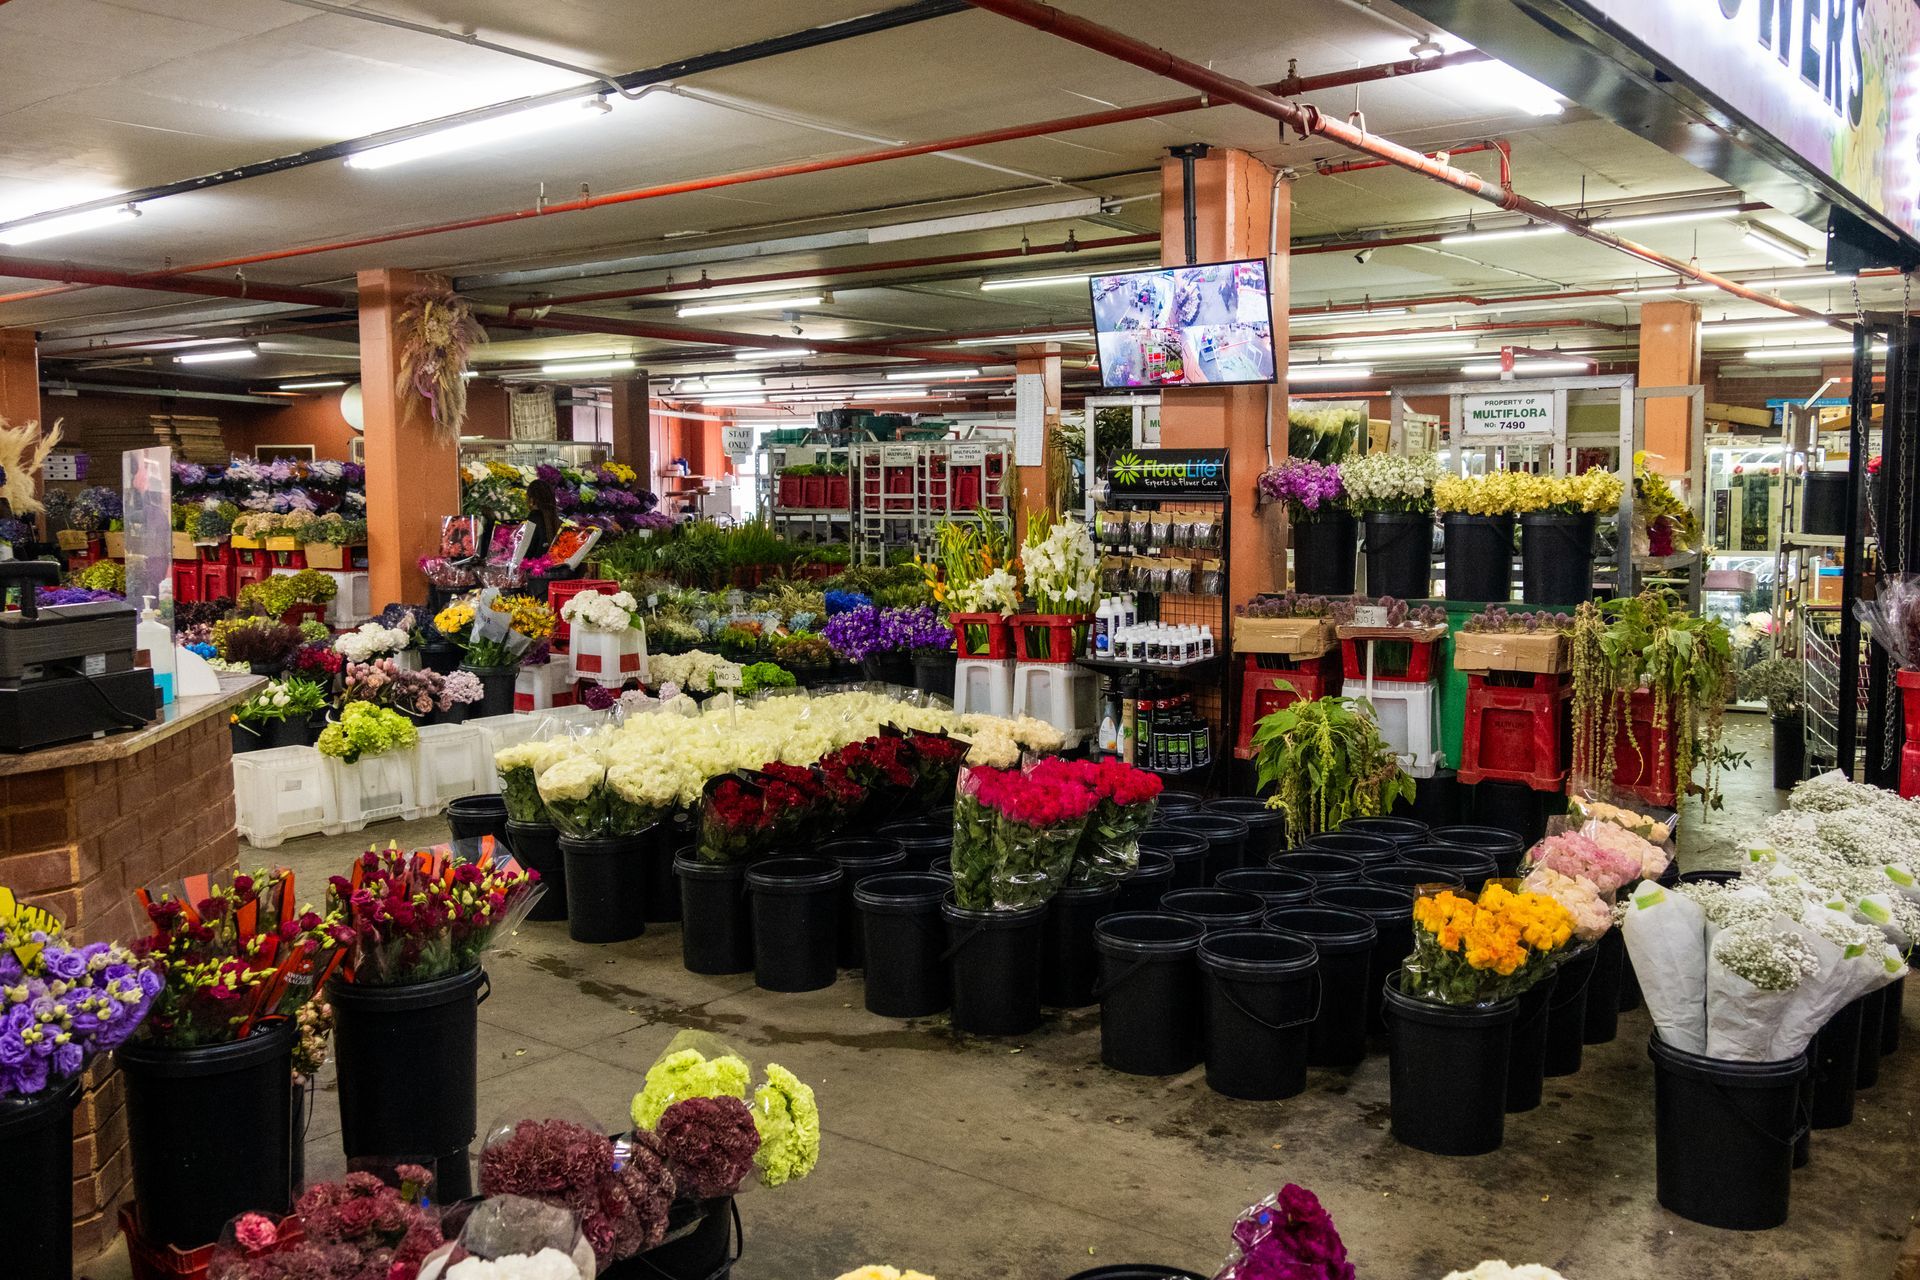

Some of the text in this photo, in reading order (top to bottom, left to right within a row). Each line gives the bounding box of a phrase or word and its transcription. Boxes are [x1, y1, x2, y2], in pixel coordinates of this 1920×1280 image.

[1473, 407, 1547, 419] MULTIFLORA
[1499, 421, 1526, 430] 7490
[728, 430, 750, 438] STAFF
[1144, 479, 1170, 488] Experts
[1179, 478, 1200, 486] Flower
[1201, 477, 1218, 486] Care
